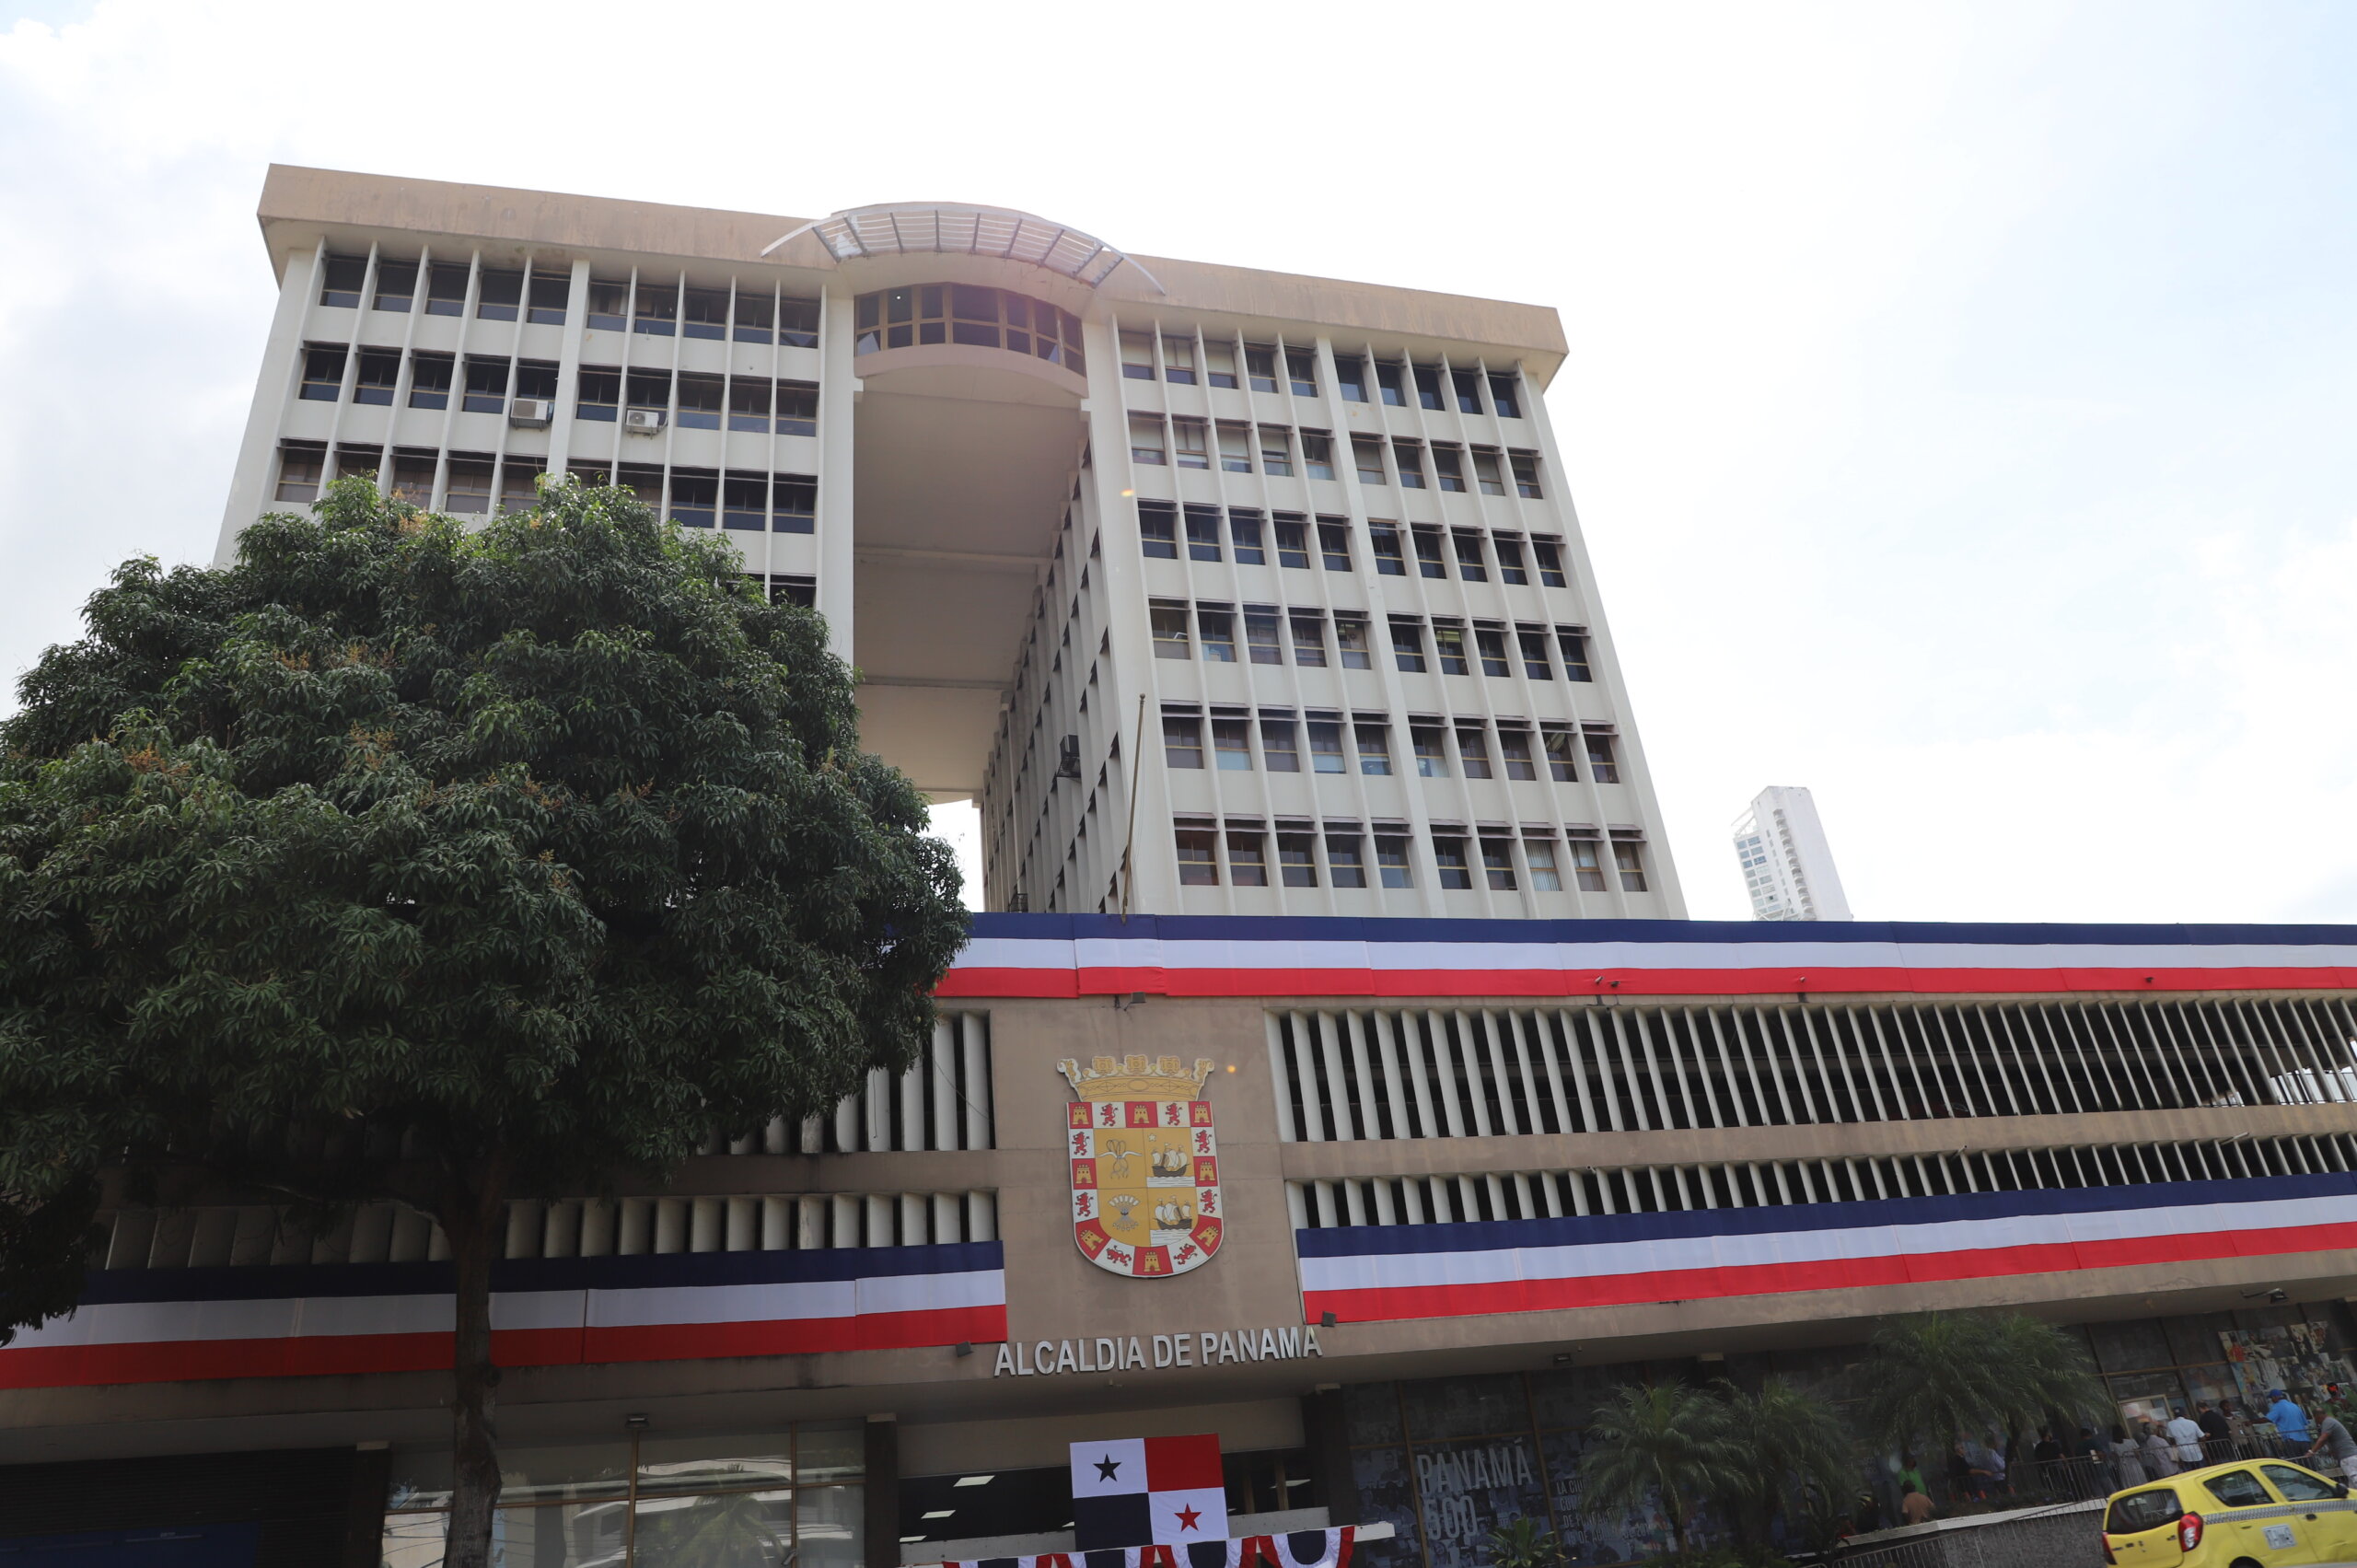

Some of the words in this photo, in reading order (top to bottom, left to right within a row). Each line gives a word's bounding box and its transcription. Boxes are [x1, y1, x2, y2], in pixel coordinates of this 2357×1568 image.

[994, 1337, 1147, 1376] ALCALDIA
[1153, 1333, 1192, 1368] DE
[1200, 1325, 1323, 1365] PANAMA
[1556, 1481, 1568, 1495] LA
[1424, 1495, 1479, 1540] 500
[1562, 1514, 1575, 1529] DE
